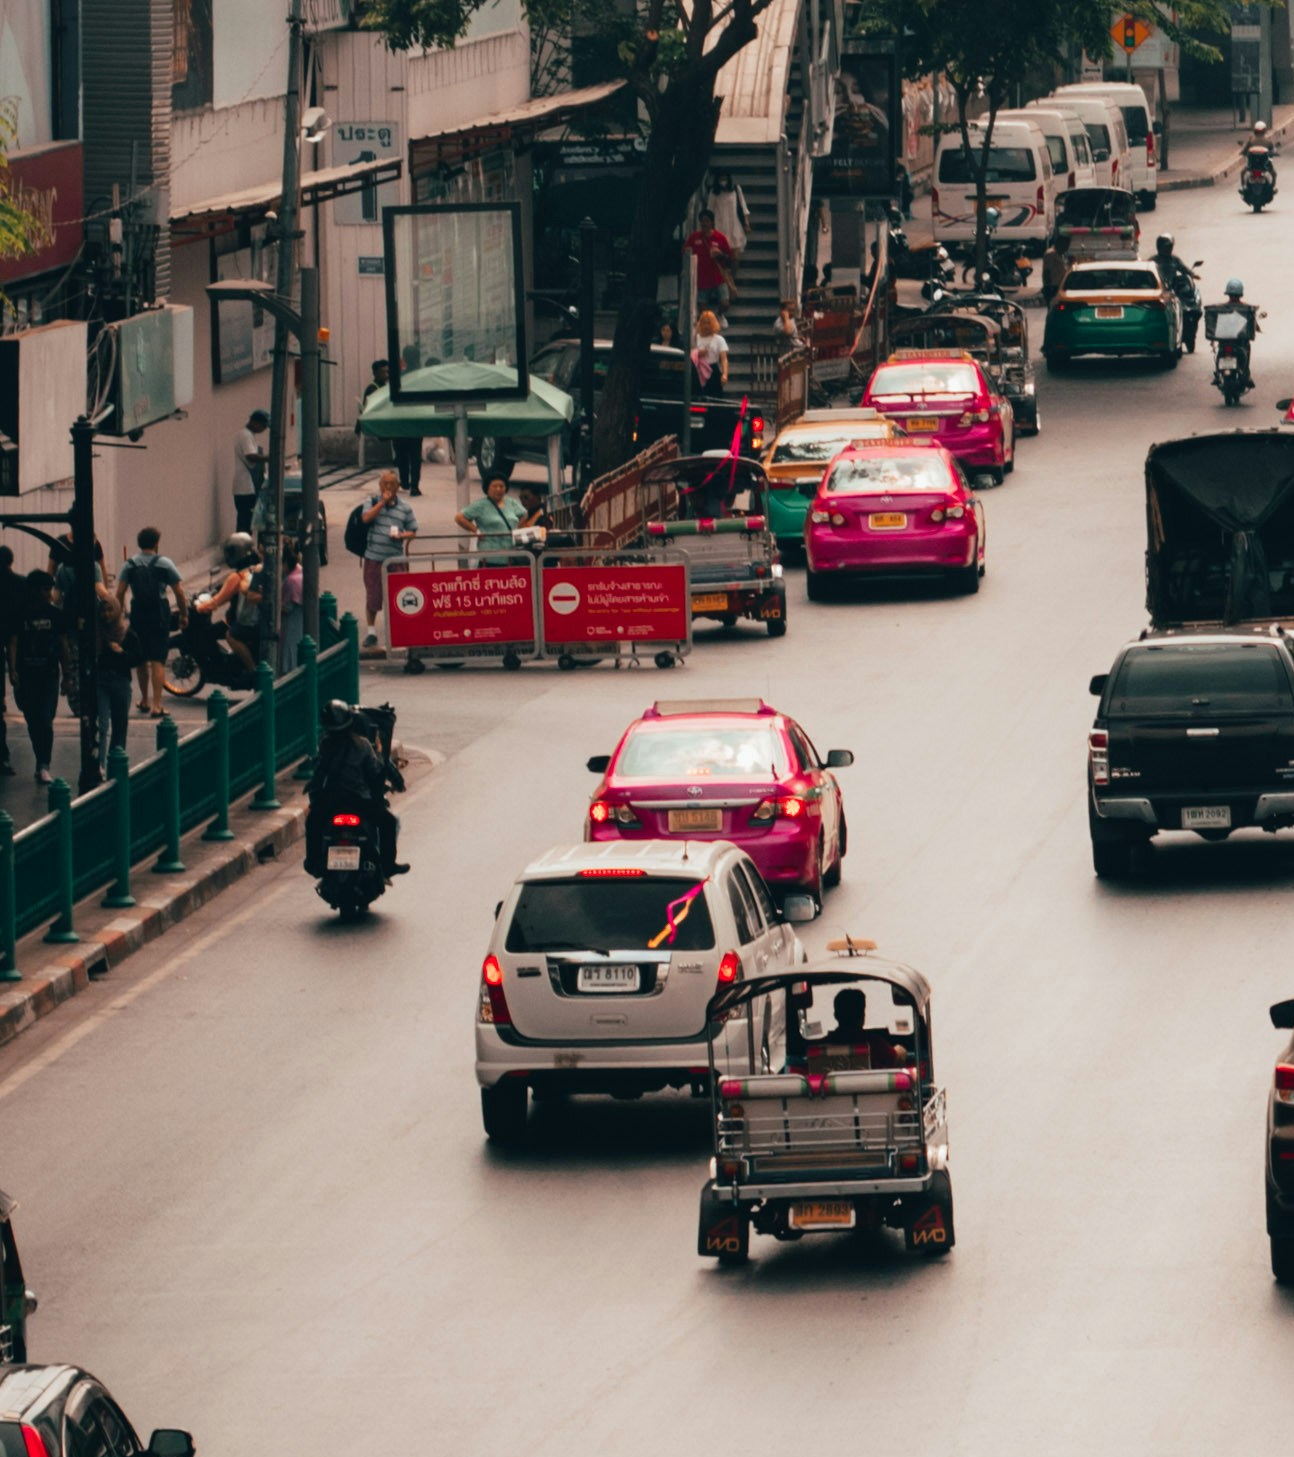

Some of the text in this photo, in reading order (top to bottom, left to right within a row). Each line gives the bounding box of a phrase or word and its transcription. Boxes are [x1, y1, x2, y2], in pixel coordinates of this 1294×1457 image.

[338, 126, 392, 147] ประตู
[432, 573, 527, 592] รถแท็กซี่ สามล้อ
[433, 595, 451, 608] ฟรี
[456, 596, 471, 607] 15
[605, 968, 634, 980] 8110
